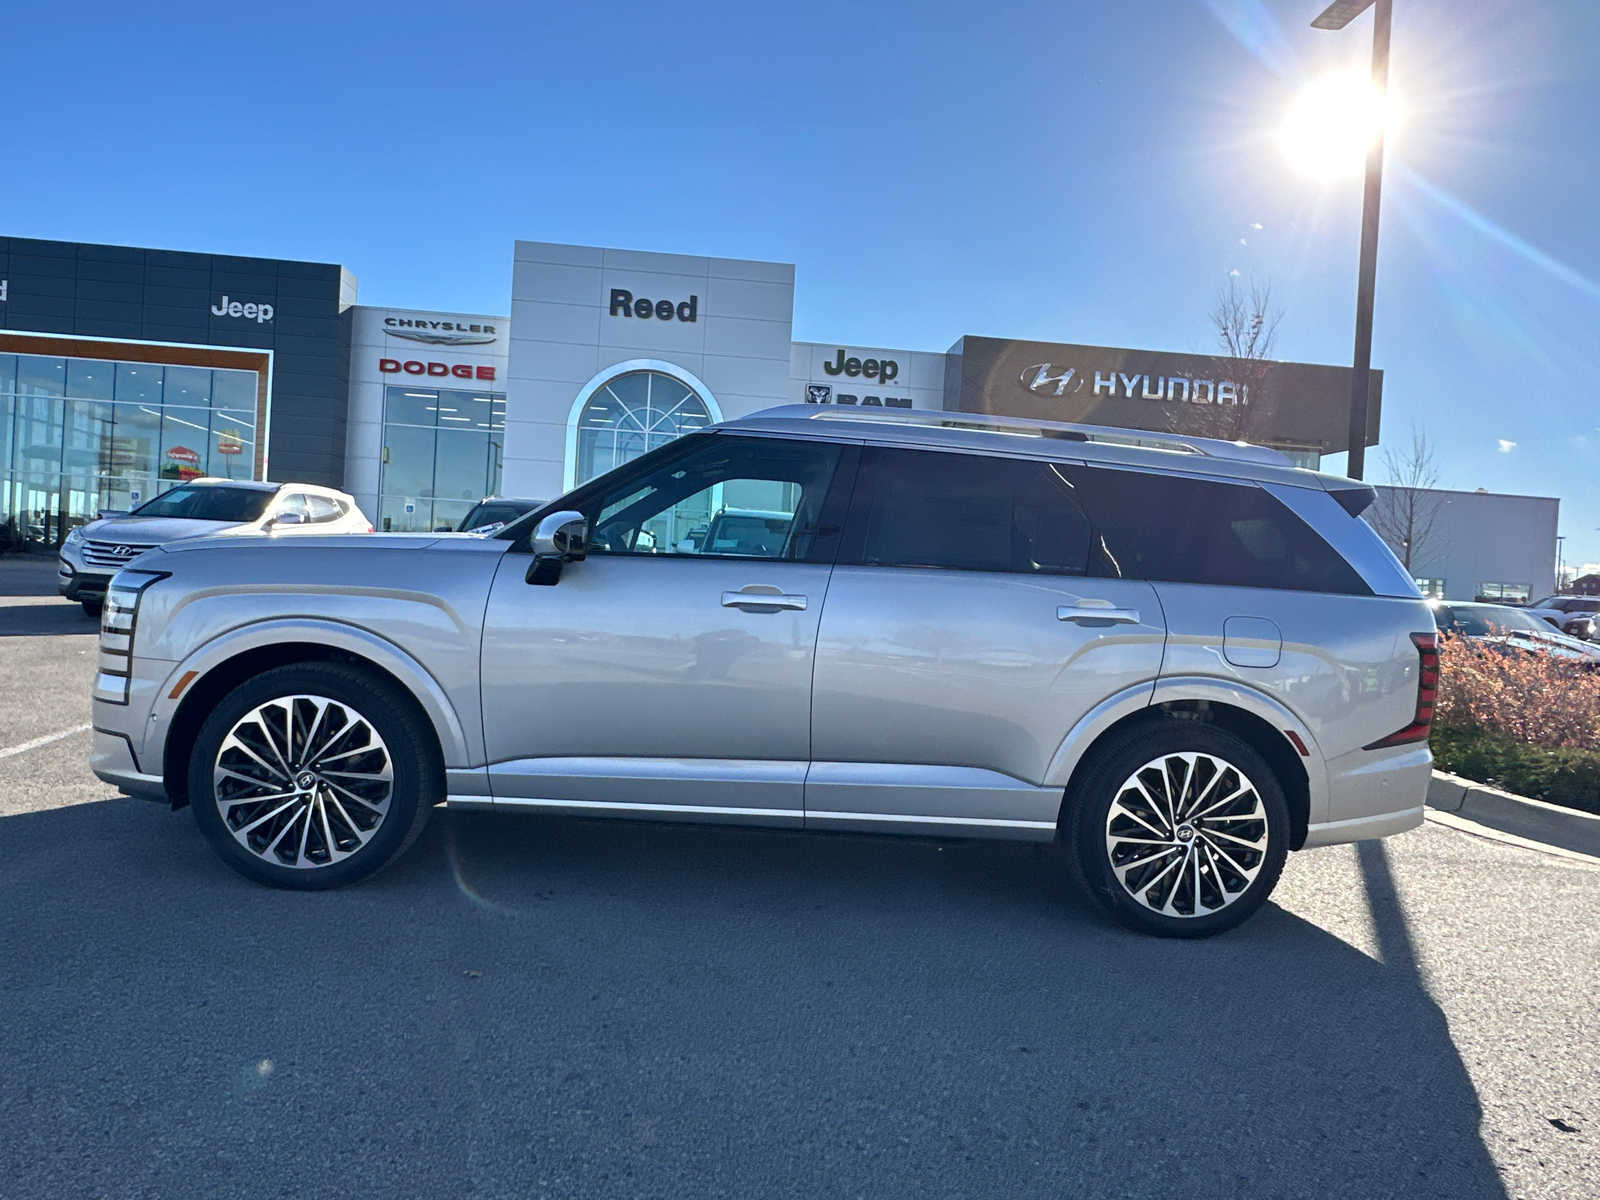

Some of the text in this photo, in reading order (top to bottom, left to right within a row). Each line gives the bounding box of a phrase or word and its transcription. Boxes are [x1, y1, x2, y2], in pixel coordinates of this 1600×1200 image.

[211, 295, 274, 324] Jeep
[609, 288, 698, 323] Reed
[384, 317, 496, 335] CHRYSLER
[379, 358, 496, 380] DODGE
[824, 349, 899, 385] Jeep
